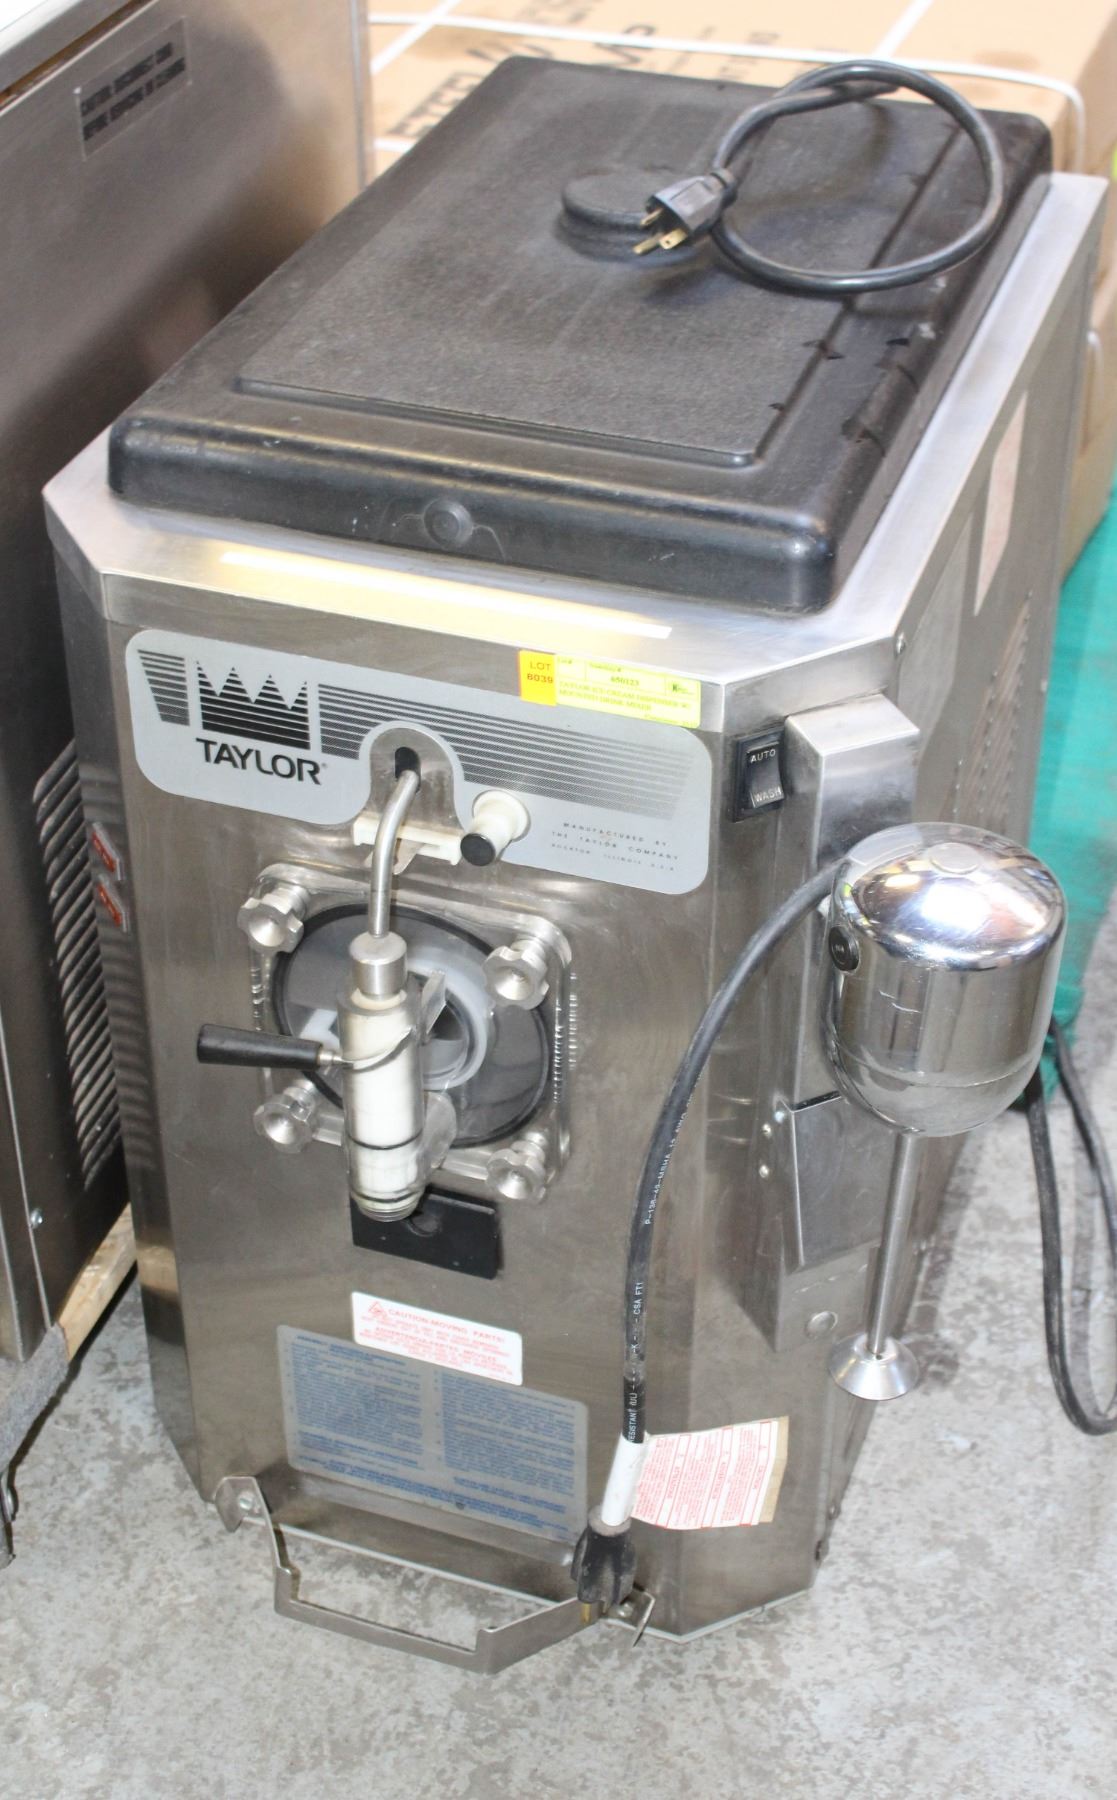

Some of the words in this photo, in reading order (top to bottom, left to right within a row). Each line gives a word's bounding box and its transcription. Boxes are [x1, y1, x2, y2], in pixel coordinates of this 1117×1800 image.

[529, 661, 551, 671] LOT
[195, 737, 322, 785] TAYLOR
[750, 748, 776, 764] AUTO
[754, 786, 782, 803] WASH
[563, 822, 645, 842] MANUFACTURED
[655, 839, 668, 847] BY
[551, 831, 569, 839] THE
[579, 836, 618, 849] TAYLOR
[628, 846, 679, 861] COMPANY
[635, 1282, 643, 1296] FT1
[633, 1298, 642, 1315] CSA
